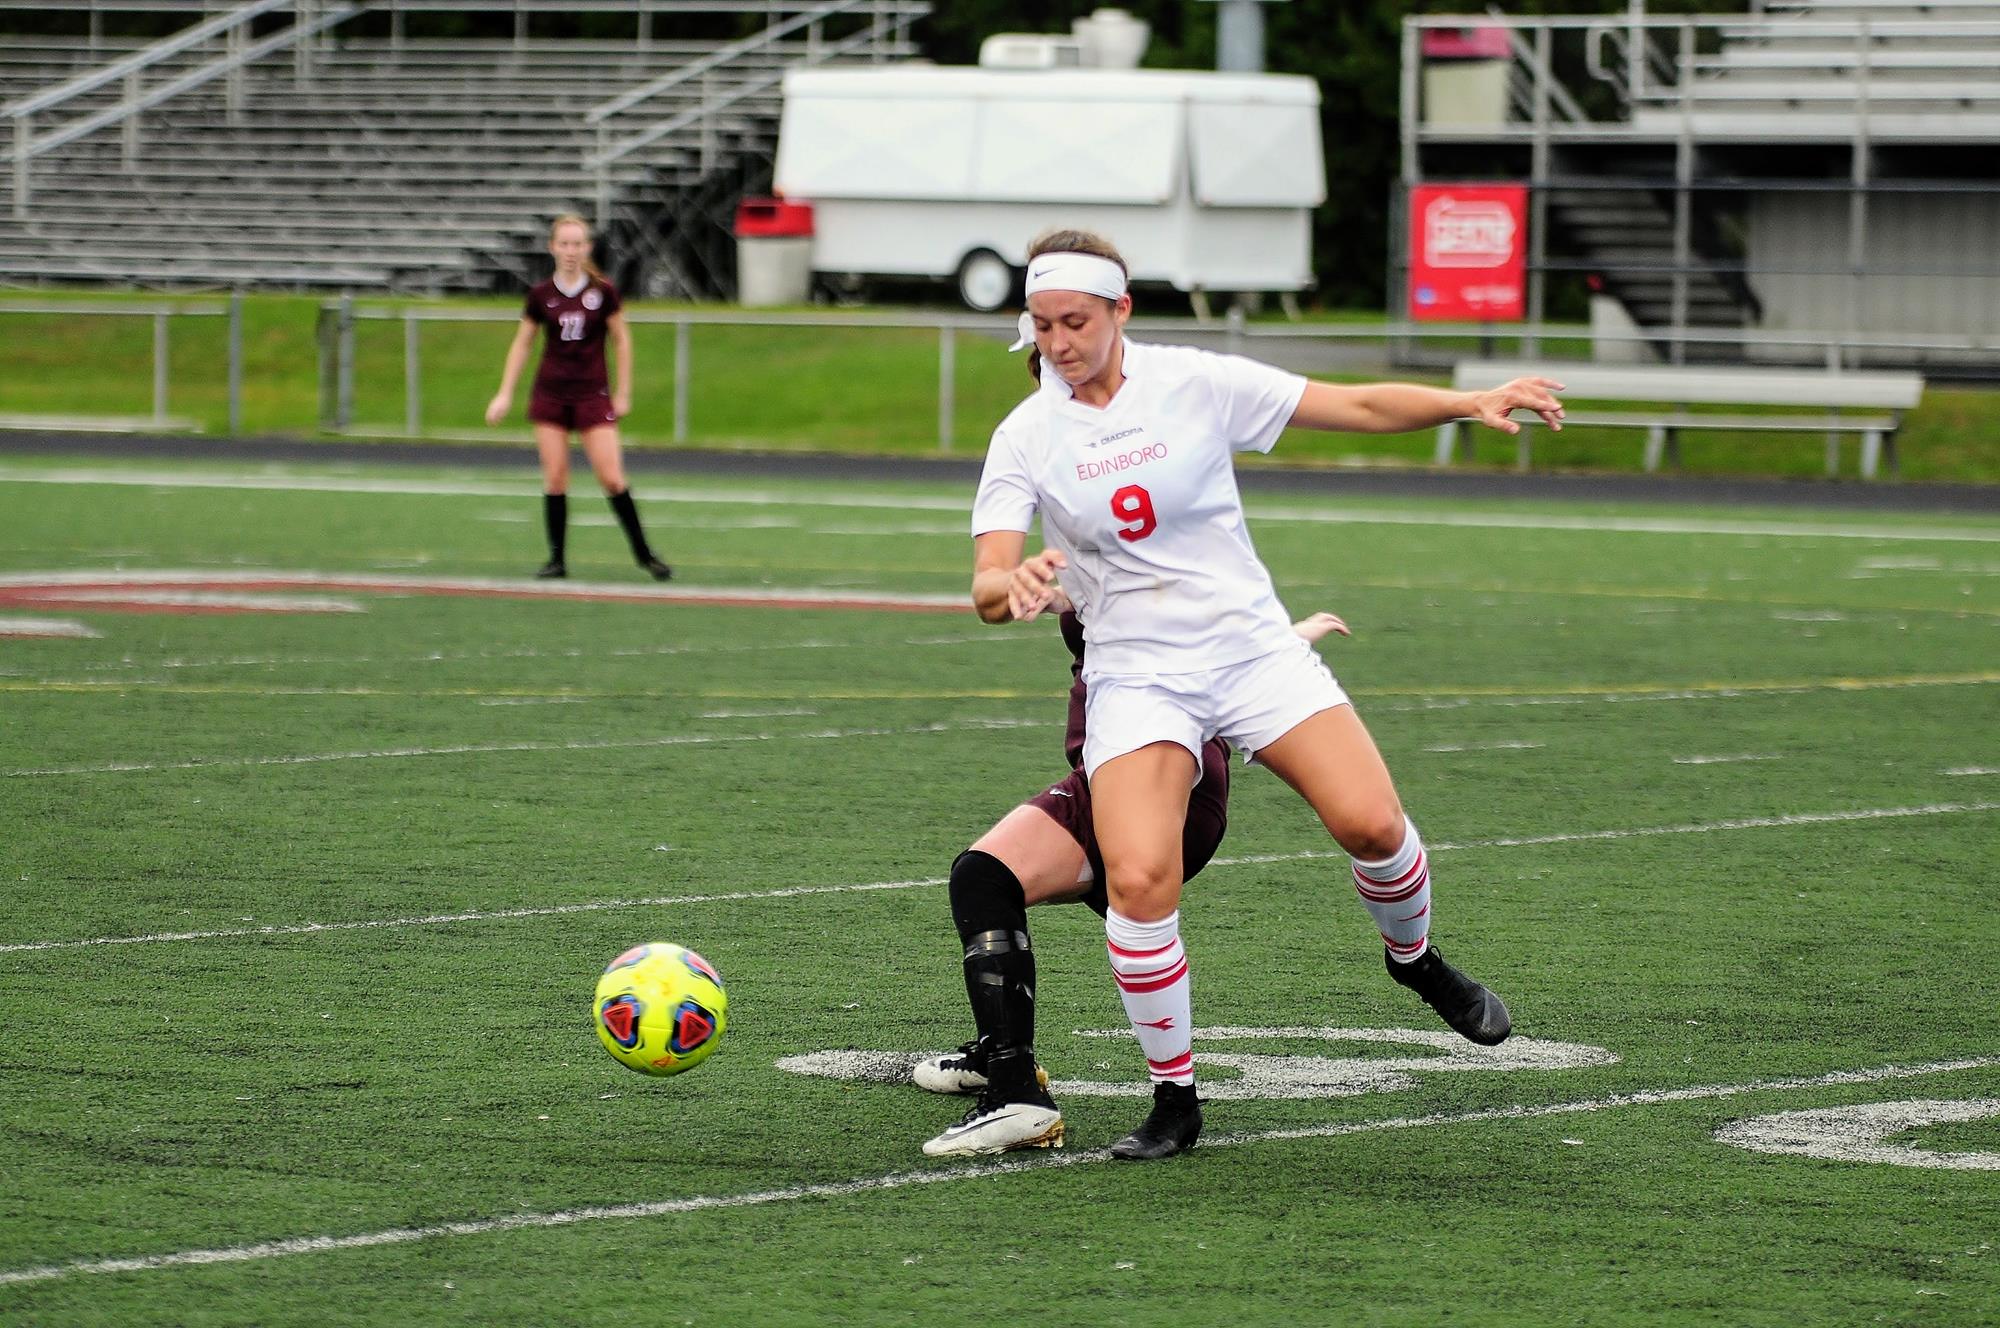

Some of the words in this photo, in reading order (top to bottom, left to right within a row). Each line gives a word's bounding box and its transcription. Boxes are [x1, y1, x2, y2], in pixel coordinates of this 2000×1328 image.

[1101, 427, 1144, 445] DIADORA
[1076, 443, 1167, 481] EDINBORO
[1111, 484, 1158, 543] 9
